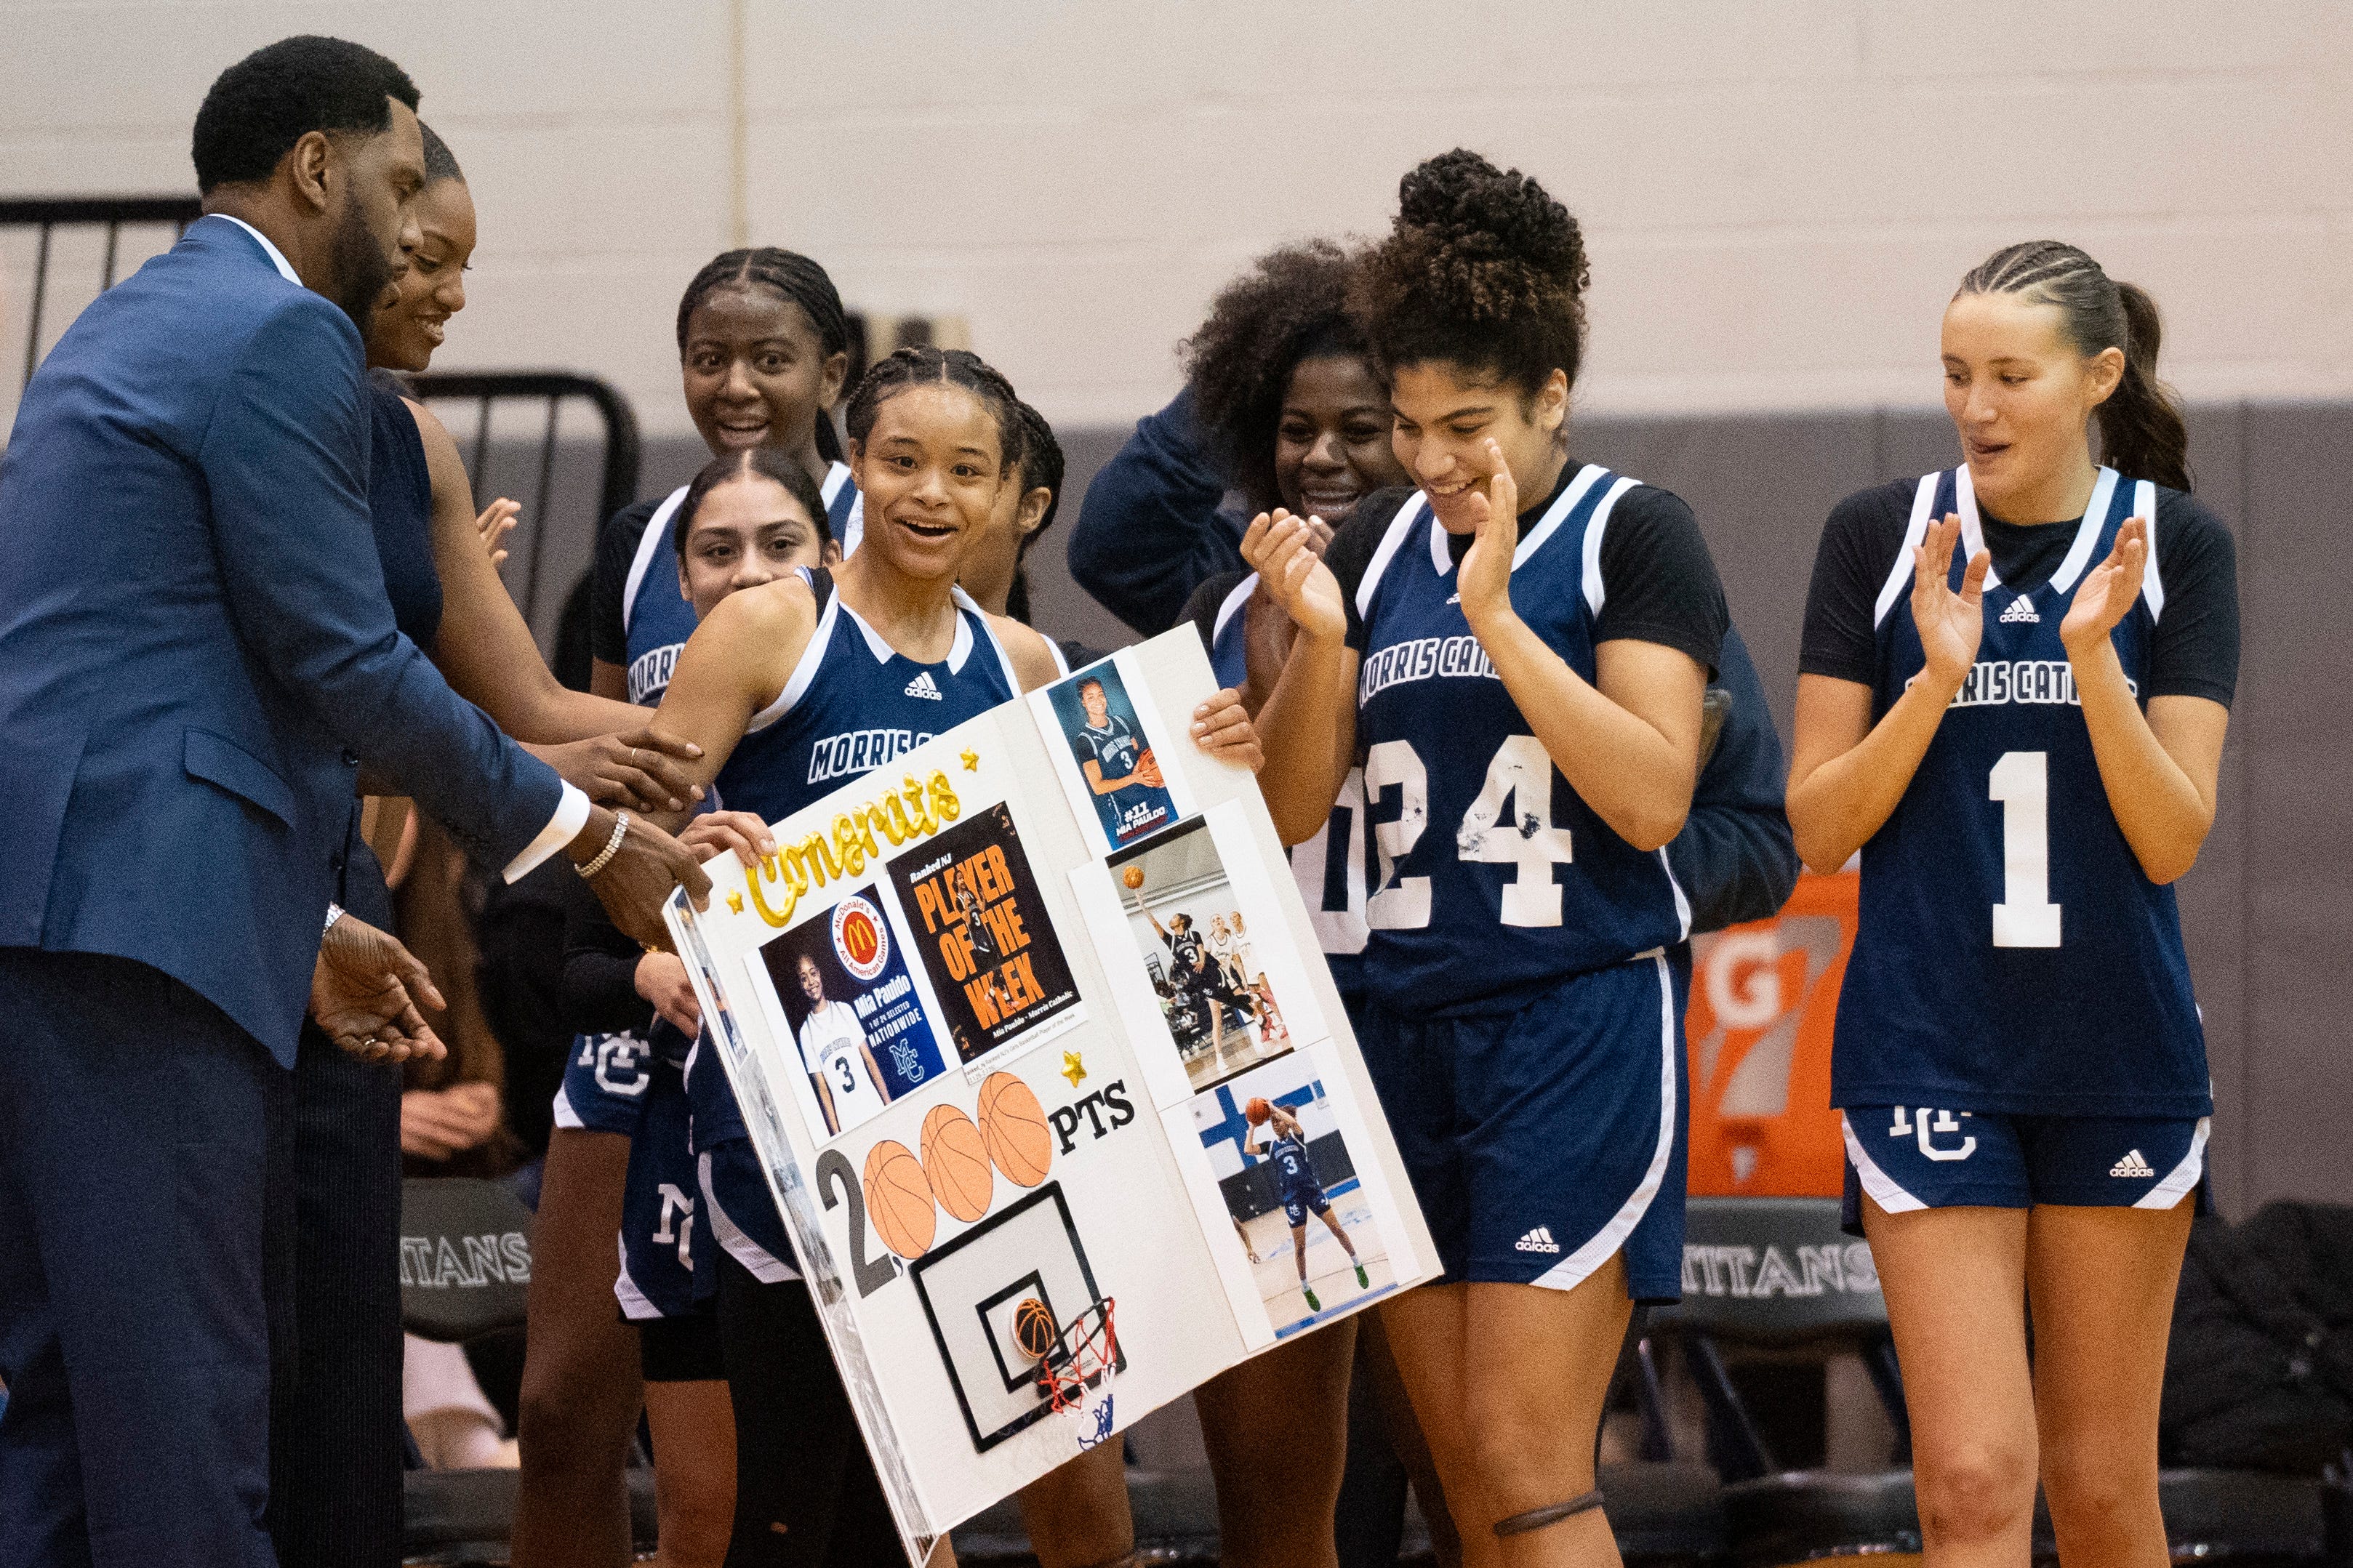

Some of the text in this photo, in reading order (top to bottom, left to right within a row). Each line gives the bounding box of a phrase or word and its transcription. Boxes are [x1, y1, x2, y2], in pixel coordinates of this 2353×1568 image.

[2000, 611, 2040, 623] adidas
[628, 643, 686, 705] MORR
[904, 686, 942, 701] adidas
[1360, 638, 1440, 709] MORRIS
[807, 729, 911, 785] MORRIS
[1120, 751, 1133, 770] 3
[1116, 822, 1133, 837] MIA
[1132, 806, 1166, 829] PAULDO
[1124, 801, 1150, 823] #11
[1365, 735, 1571, 929] 24
[745, 768, 960, 928] Congrats
[910, 853, 952, 883] Ranked NJ
[1989, 751, 2061, 947] 1
[913, 844, 1015, 934] PLAYER
[835, 900, 870, 930] McDonald's
[971, 912, 981, 926] 3
[840, 927, 886, 977] All American Games
[939, 923, 977, 981] OF
[1184, 948, 1198, 963] 3
[854, 975, 911, 1019] Mia Pauldo
[963, 952, 1046, 1031] WEEK
[1707, 930, 1781, 1029] G
[868, 1008, 922, 1048] NATIONWIDE
[873, 1018, 880, 1027] OF
[886, 1000, 910, 1018] SELECTED
[992, 1028, 1004, 1039] Mia
[1048, 991, 1073, 1008] Catholic
[835, 1056, 855, 1093] 3
[1048, 1079, 1135, 1156] PTS
[1283, 1156, 1298, 1175] 3
[2110, 1167, 2154, 1177] adidas
[400, 1232, 532, 1287] ITANS
[1515, 1241, 1560, 1253] adidas
